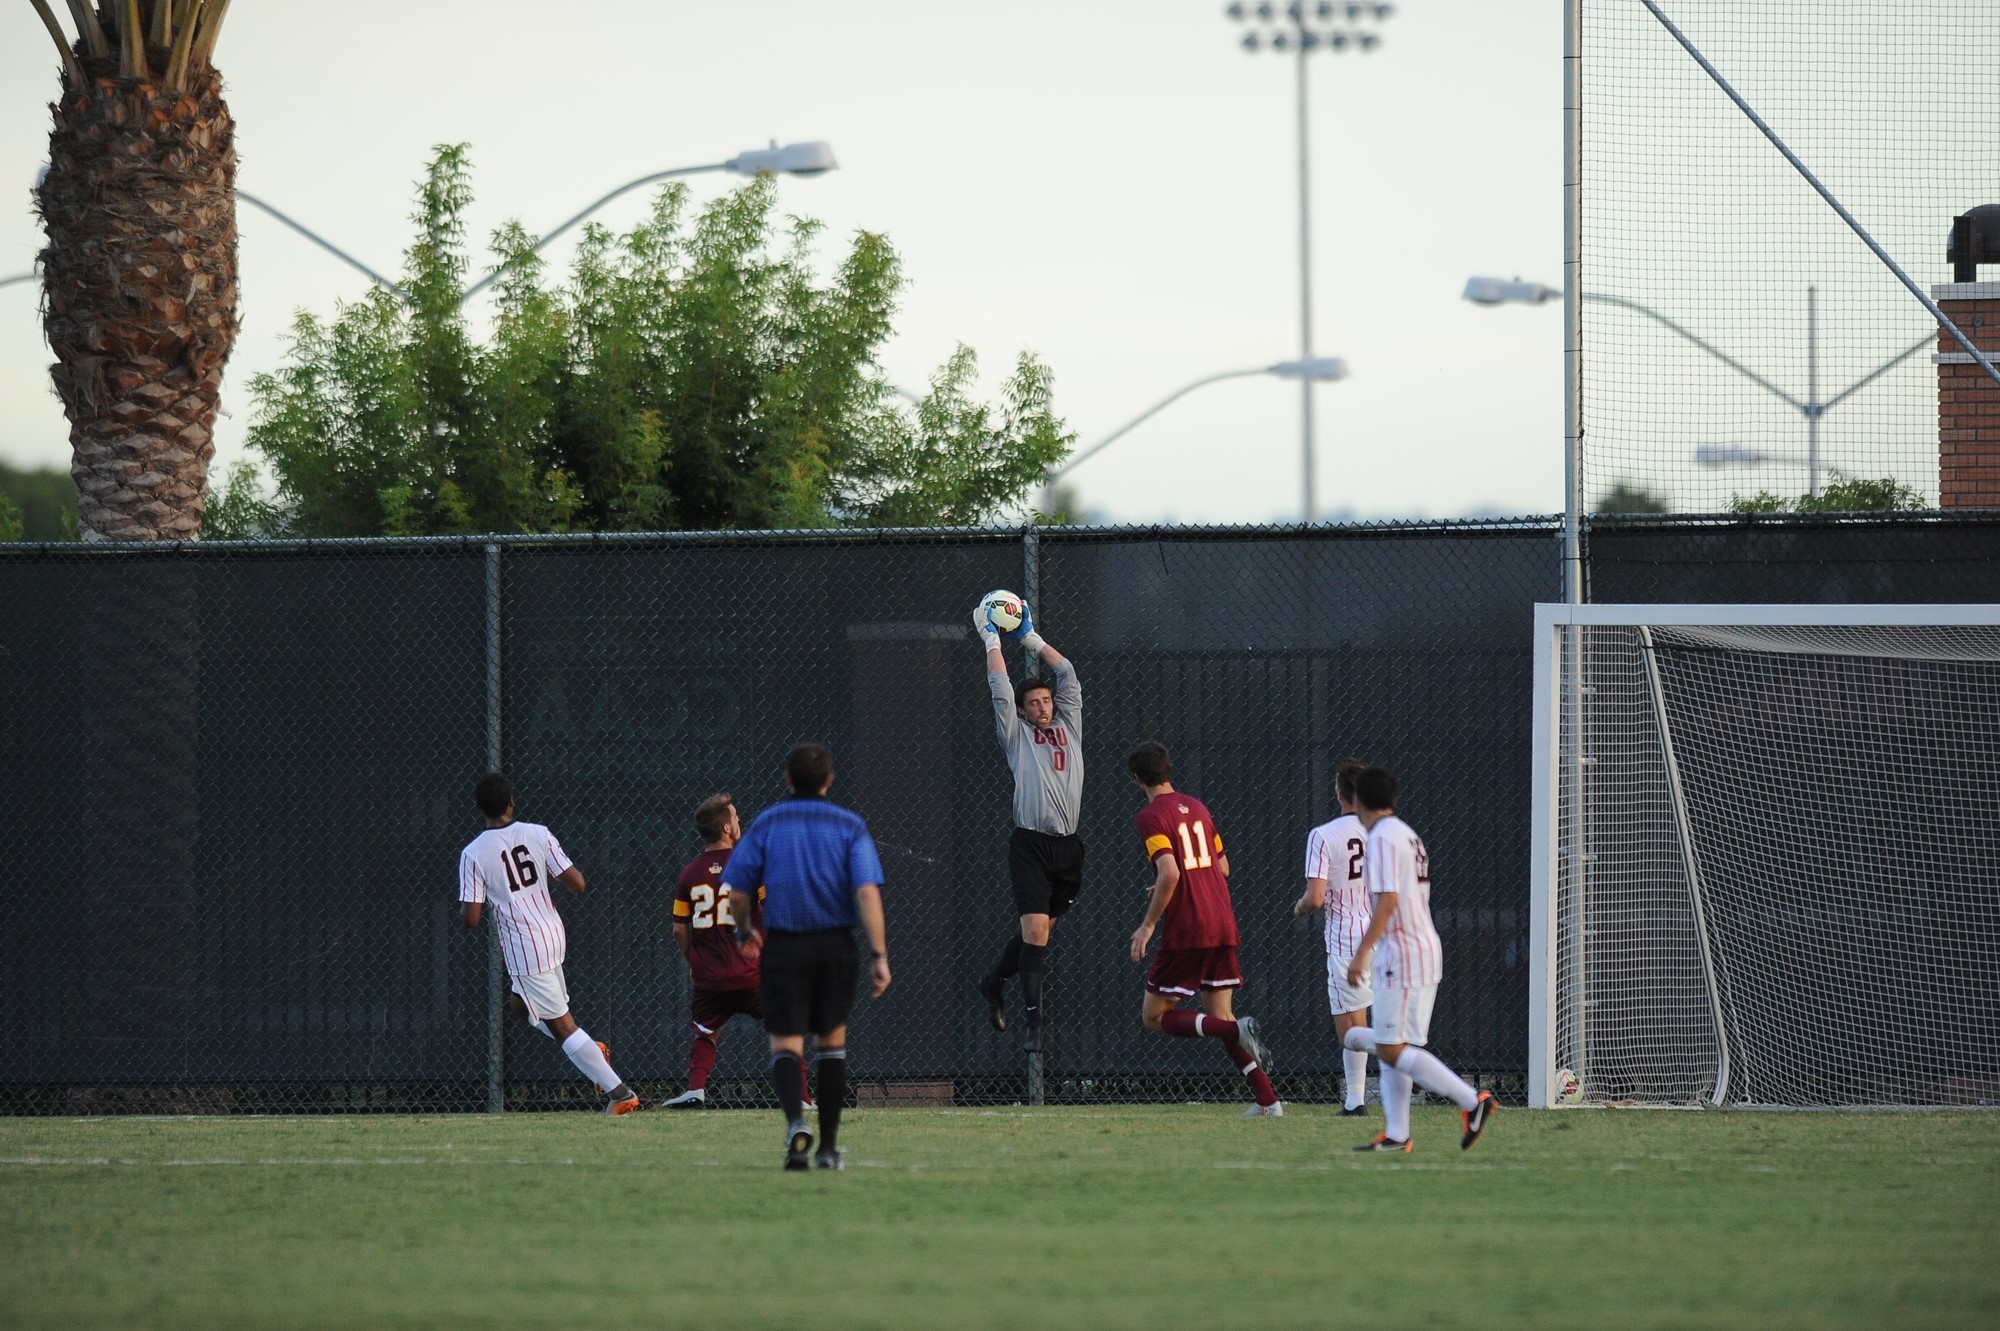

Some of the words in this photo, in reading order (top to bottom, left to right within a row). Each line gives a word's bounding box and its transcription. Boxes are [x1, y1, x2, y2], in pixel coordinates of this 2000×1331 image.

[500, 844, 539, 893] 16
[1178, 820, 1212, 870] 11
[1347, 838, 1364, 880] 2
[690, 883, 737, 929] 22
